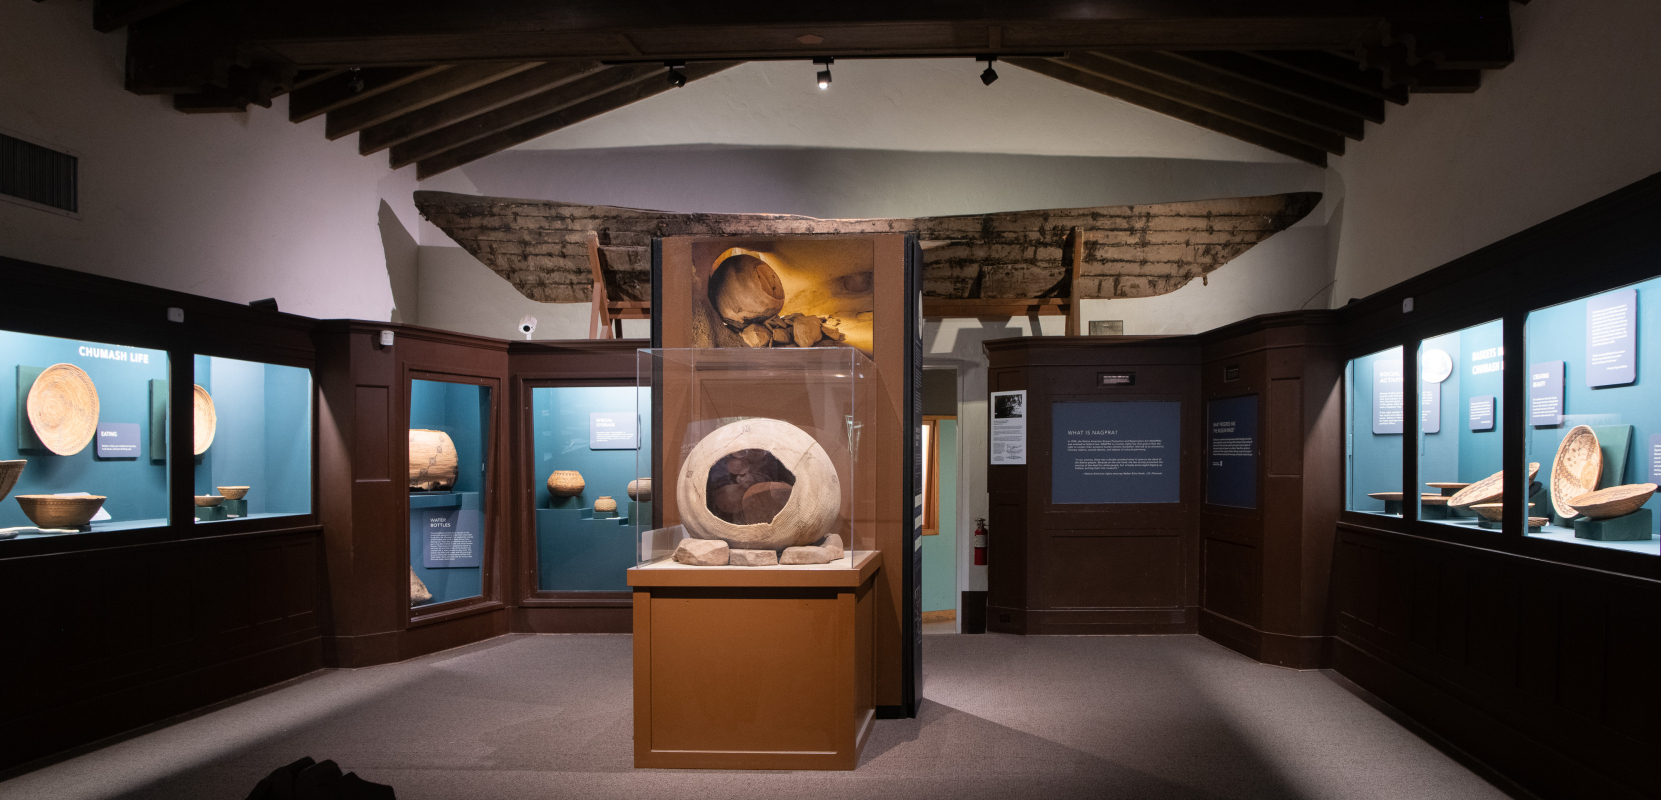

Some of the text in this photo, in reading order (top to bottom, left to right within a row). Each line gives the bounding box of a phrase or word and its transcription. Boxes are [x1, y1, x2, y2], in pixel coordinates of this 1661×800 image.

[79, 346, 149, 364] CHUMASH LIFE
[1472, 348, 1496, 361] BASKETS
[1472, 362, 1500, 375] CHUMASH
